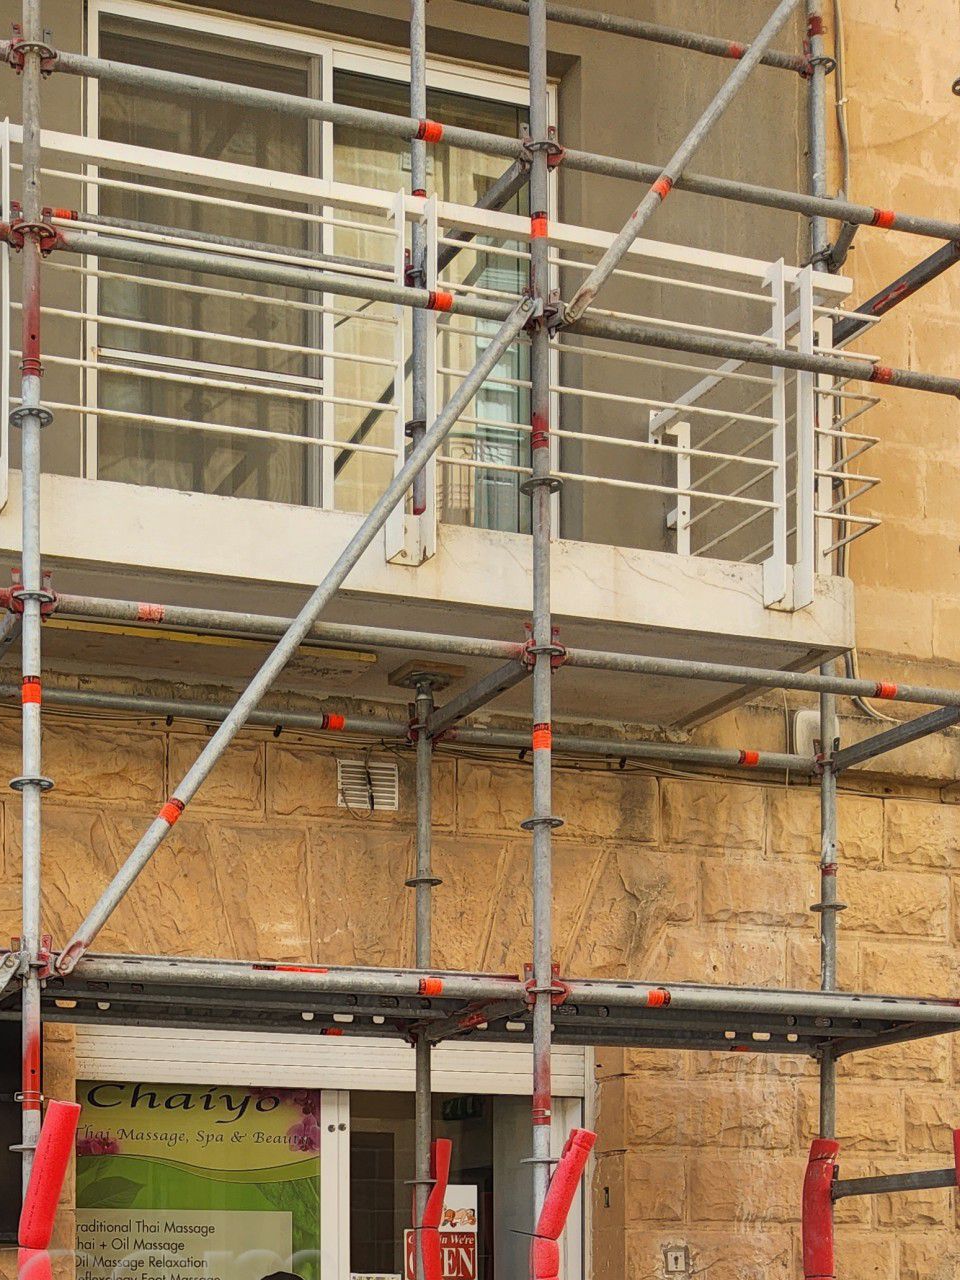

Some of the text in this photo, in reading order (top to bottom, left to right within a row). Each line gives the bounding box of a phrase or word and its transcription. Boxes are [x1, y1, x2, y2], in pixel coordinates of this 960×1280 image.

[87, 1083, 281, 1124] Chaiyo
[76, 1124, 309, 1150] Thai Massage, Spa & Beauty
[76, 1219, 215, 1236] raditional Thai Massage
[76, 1236, 95, 1250] hai
[111, 1237, 130, 1250] Oil
[134, 1238, 185, 1253] Massage
[93, 1256, 145, 1271] Massage
[149, 1255, 208, 1269] Relaxation
[409, 1247, 475, 1278] EN
